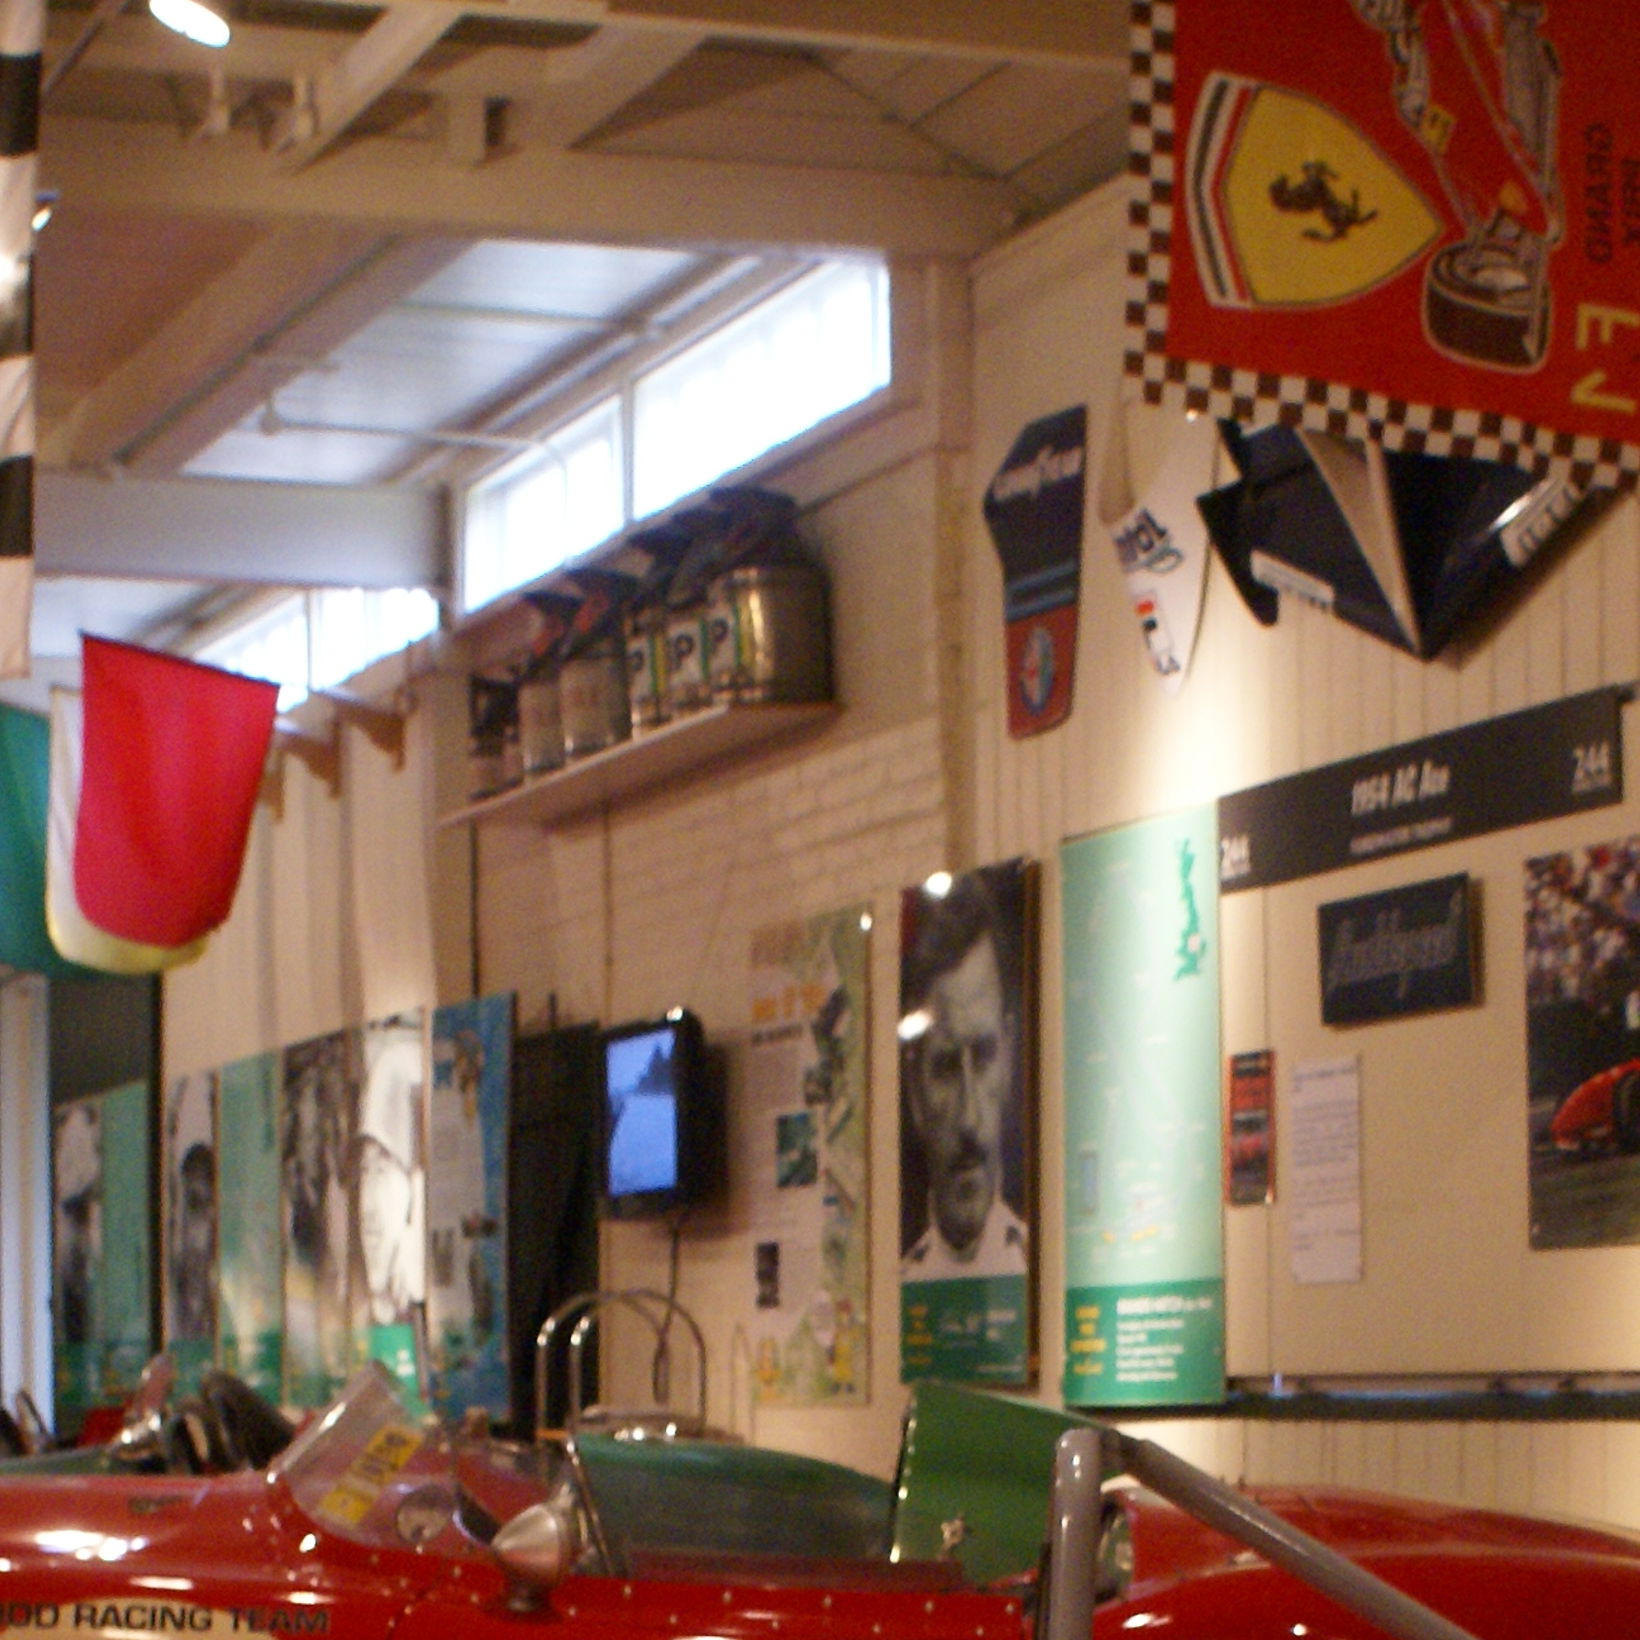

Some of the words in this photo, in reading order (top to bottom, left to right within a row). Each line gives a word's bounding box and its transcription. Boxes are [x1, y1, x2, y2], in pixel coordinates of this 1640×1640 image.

[0, 1602, 59, 1628] OD
[72, 1603, 213, 1632] RACING
[227, 1606, 329, 1634] TEAM
